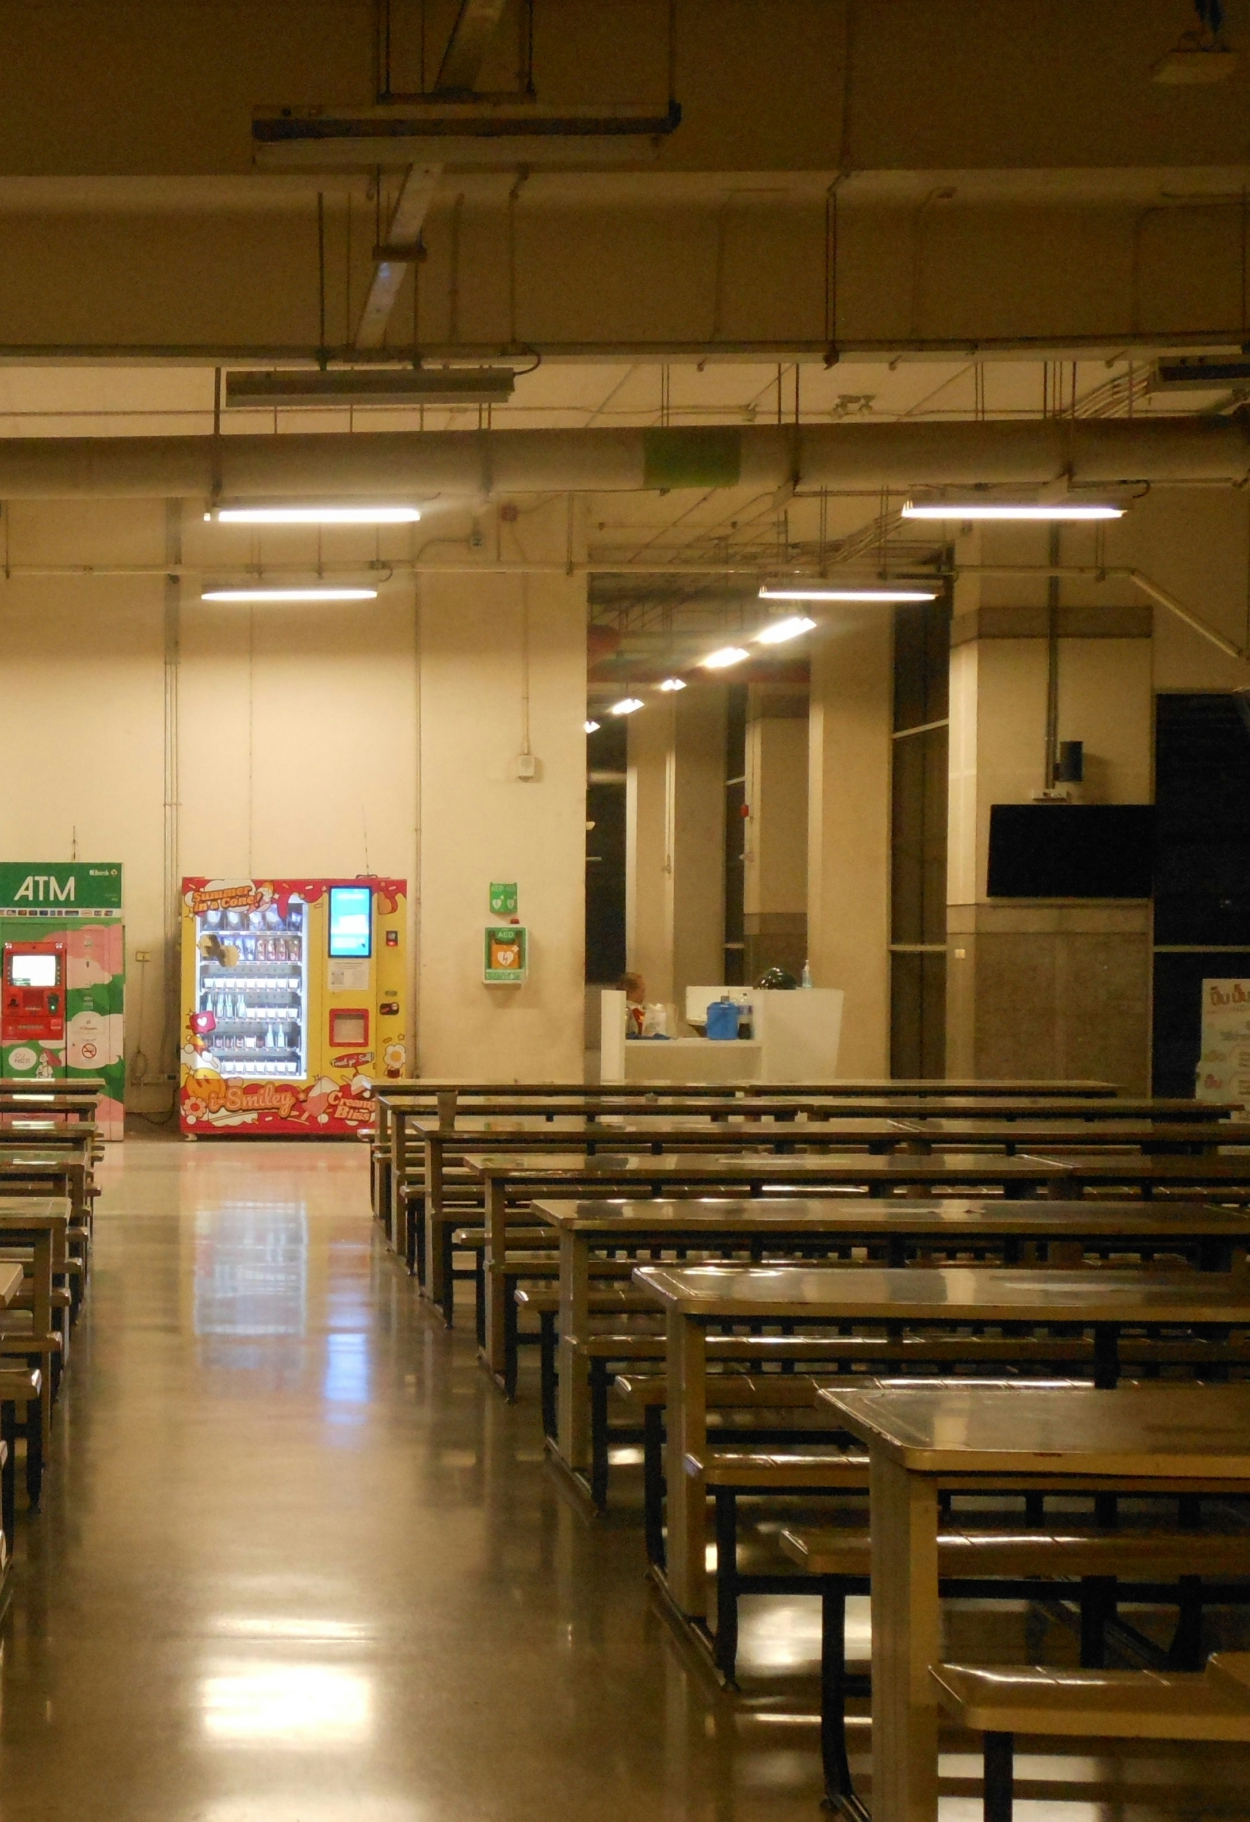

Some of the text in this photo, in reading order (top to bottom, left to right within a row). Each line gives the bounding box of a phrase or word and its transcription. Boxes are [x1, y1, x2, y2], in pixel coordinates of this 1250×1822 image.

[13, 875, 75, 901] ATM
[192, 885, 253, 903] Summer
[220, 891, 264, 909] Cone!
[497, 931, 515, 939] AED
[208, 1081, 297, 1118] i-Smiley
[334, 1104, 372, 1121] Bliss
